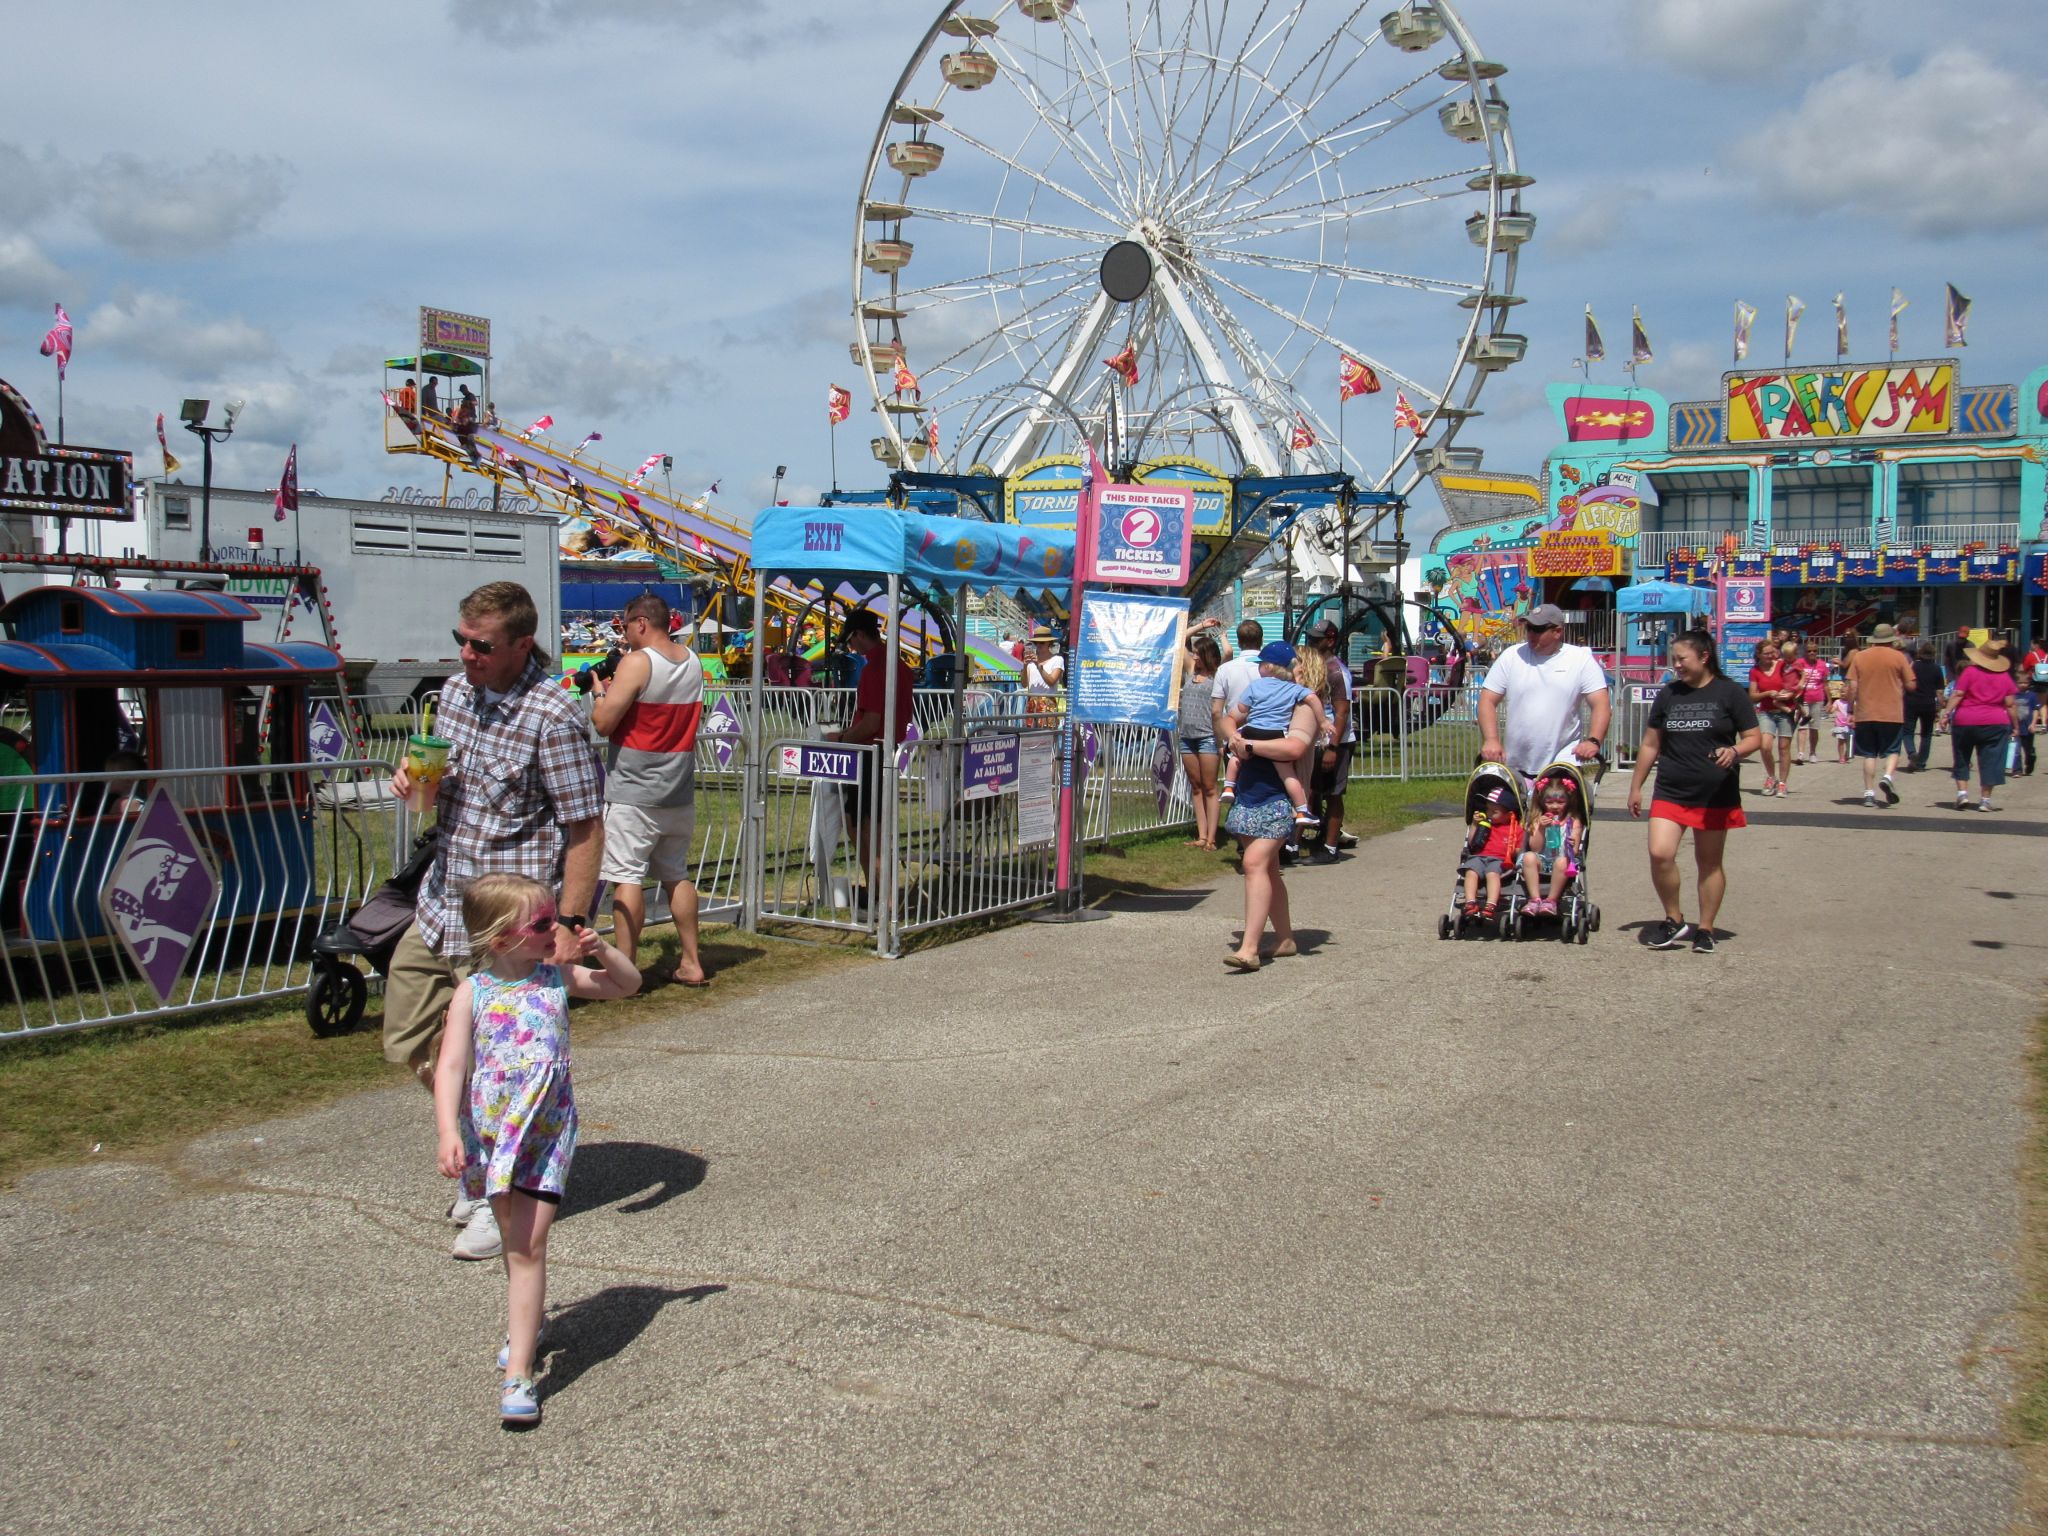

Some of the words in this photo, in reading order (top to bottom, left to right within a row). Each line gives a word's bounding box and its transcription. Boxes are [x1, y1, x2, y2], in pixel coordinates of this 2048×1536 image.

[438, 320, 485, 343] SLIDE
[1729, 370, 1869, 439] TRAFFIC
[1872, 368, 1948, 427] JAM
[0, 457, 111, 500] ATION
[1614, 473, 1633, 483] ACME
[1019, 495, 1079, 513] TORNA
[1106, 494, 1126, 502] THIS
[1128, 495, 1149, 503] RIDE
[1152, 496, 1180, 505] TAKES
[1130, 511, 1155, 542] 2
[1581, 505, 1615, 530] LETS
[1616, 509, 1640, 533] EAT
[803, 522, 844, 551] EXIT
[212, 545, 248, 562] NORTH
[1114, 548, 1164, 562] TICKETS
[1643, 592, 1664, 605] EXIT
[1740, 589, 1751, 604] 3
[1666, 720, 1713, 728] ESCAPED.
[971, 742, 994, 754] PLEASE
[995, 738, 1016, 751] REMAIN
[807, 751, 851, 776] EXIT
[983, 752, 1006, 765] SEATED
[974, 768, 984, 779] AT
[984, 766, 996, 777] ALL
[997, 763, 1013, 775] TIMES
